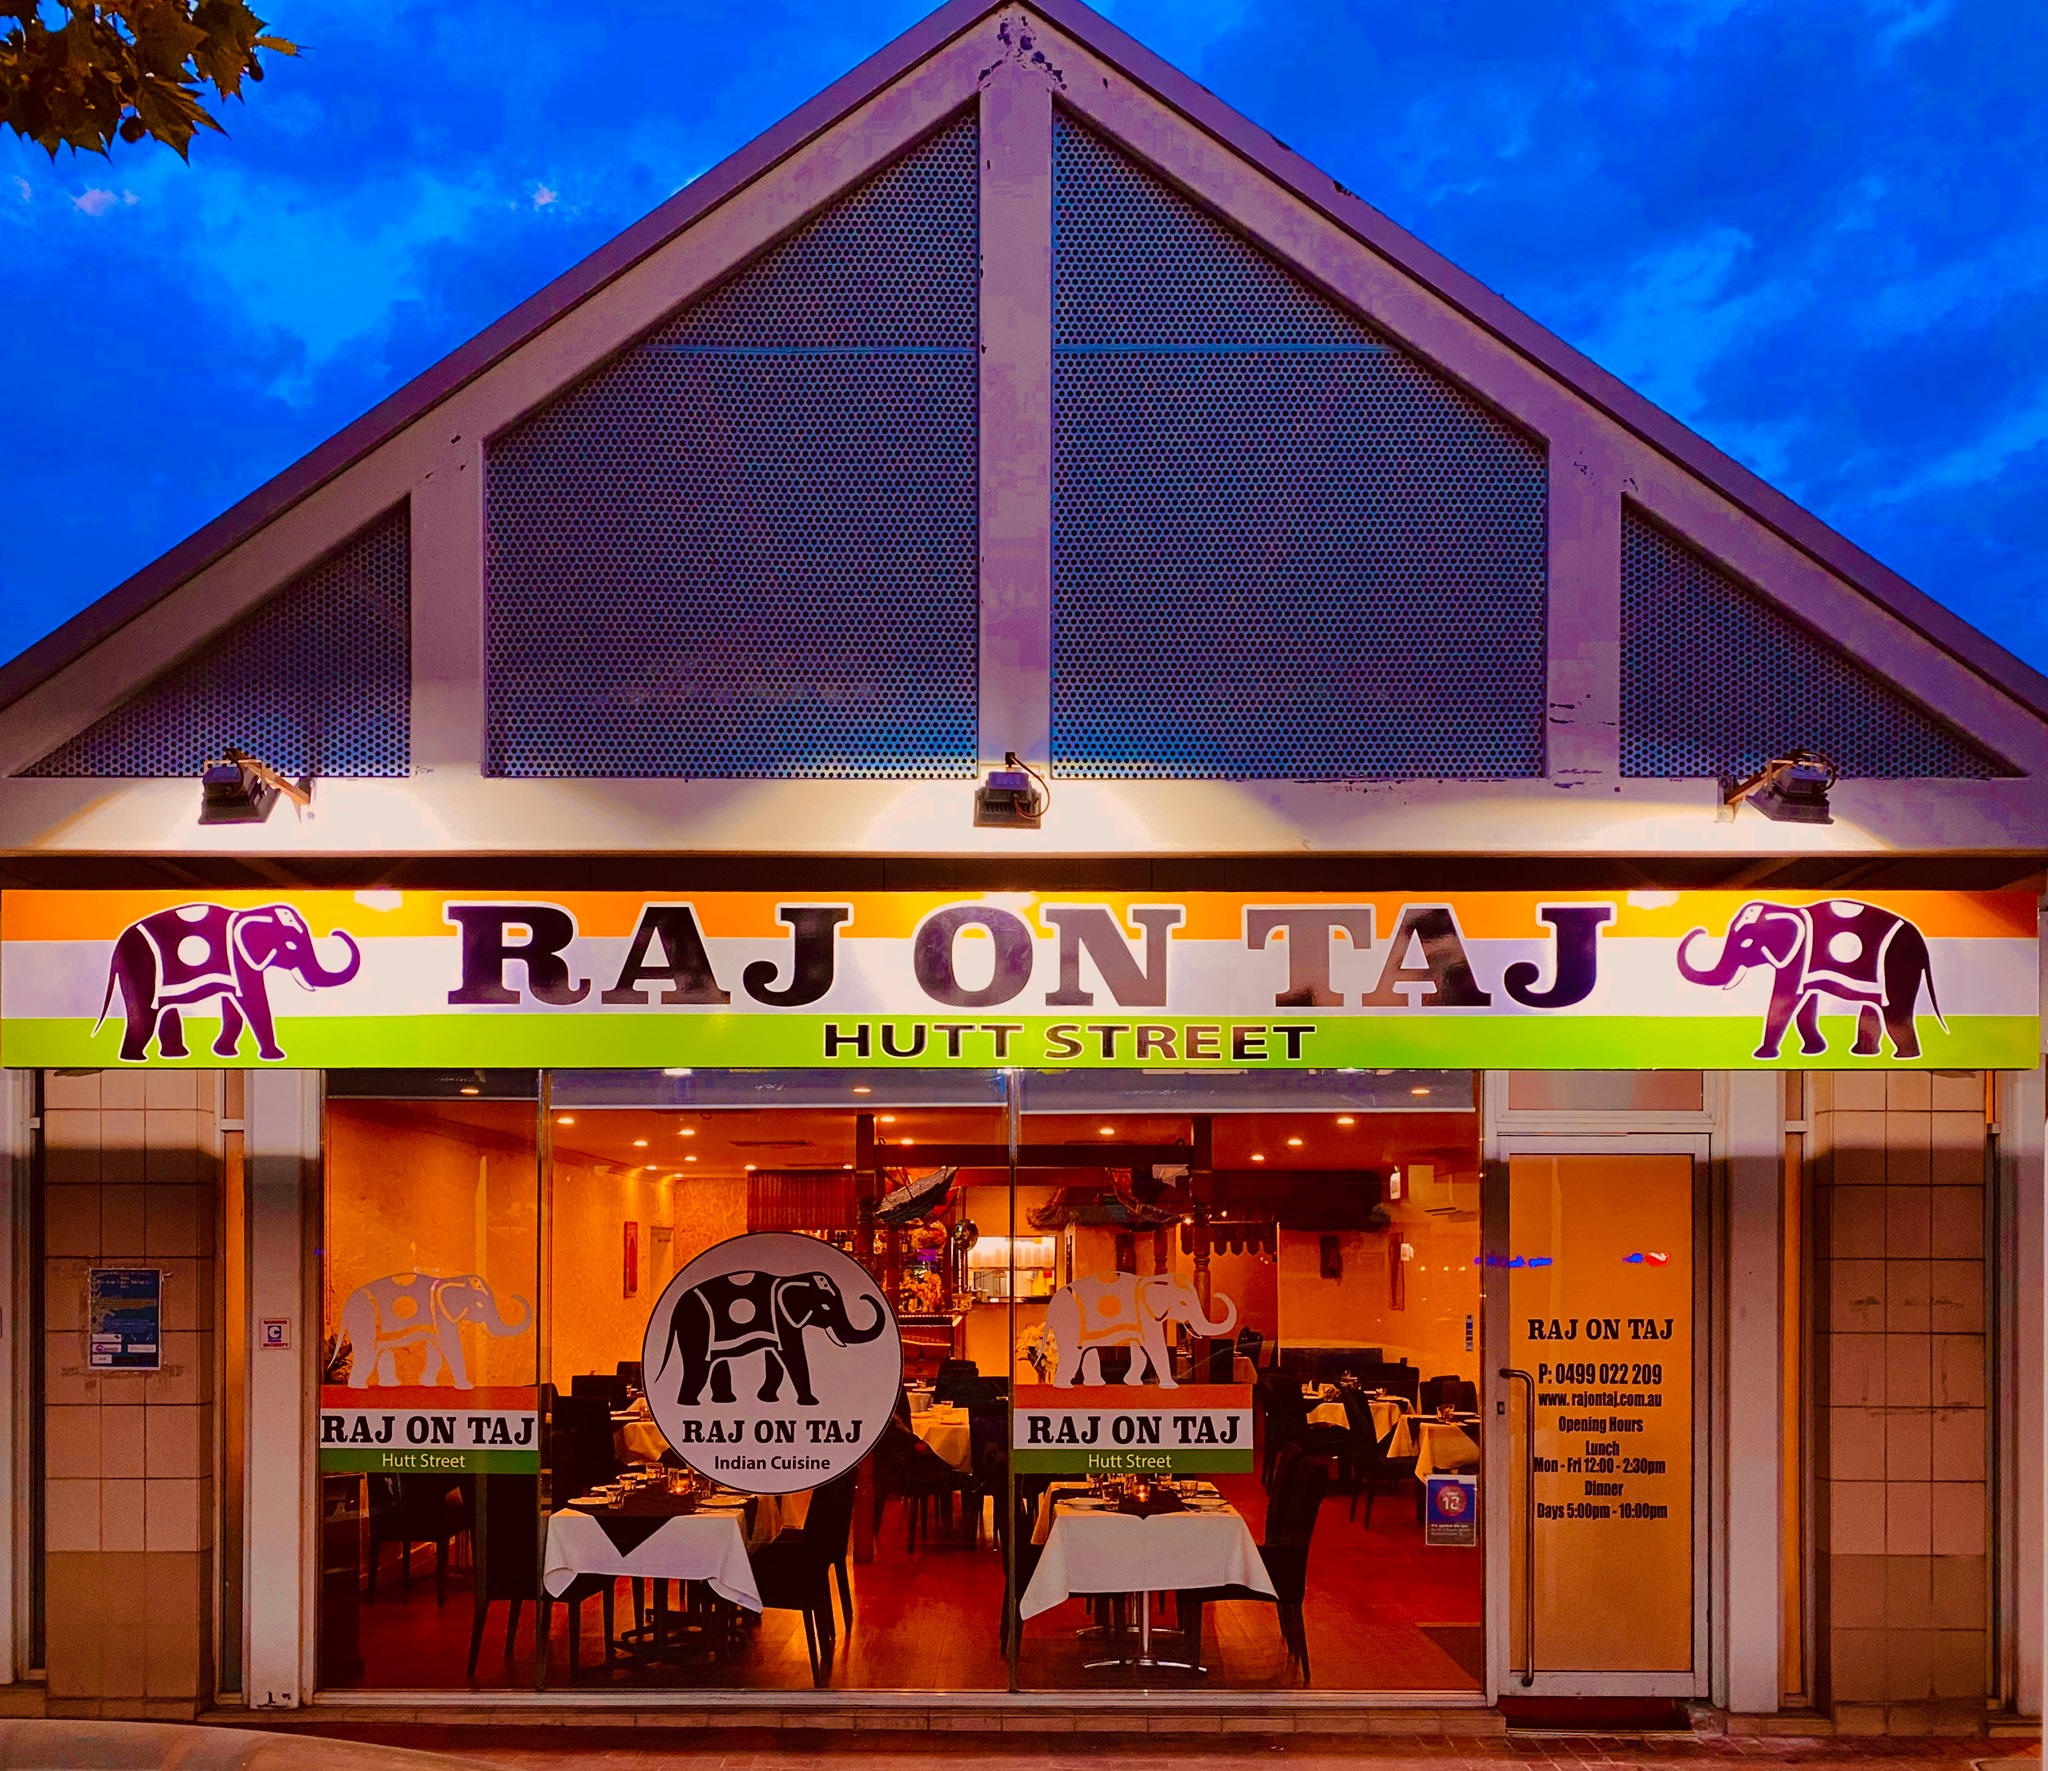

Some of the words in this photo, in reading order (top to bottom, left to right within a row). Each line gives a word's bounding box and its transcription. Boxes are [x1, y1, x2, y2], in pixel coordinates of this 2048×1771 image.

[446, 904, 854, 1008] RAJ
[913, 905, 1183, 1008] ON
[1246, 906, 1612, 1009] TAJ
[824, 1024, 1025, 1058] HUTT
[1045, 1025, 1316, 1060] STREET
[1528, 1318, 1579, 1340] RAJ
[1586, 1318, 1621, 1340] ON
[1628, 1318, 1674, 1340] TAJ
[1538, 1363, 1552, 1384] P:
[1555, 1363, 1596, 1385] 0499
[1600, 1363, 1629, 1385] 022
[1632, 1363, 1662, 1385] 209
[321, 1415, 396, 1443] RAJ
[406, 1415, 457, 1444] ON
[467, 1416, 535, 1445] TAJ
[682, 1419, 745, 1443] RAJ
[754, 1419, 797, 1443] ON
[806, 1419, 863, 1443] TAJ
[1027, 1415, 1101, 1444] RAJ
[1112, 1415, 1162, 1444] ON
[1172, 1415, 1240, 1444] TAJ
[1558, 1415, 1606, 1434] Opening
[1609, 1416, 1644, 1432] Hours
[1585, 1440, 1620, 1456] Lunch
[382, 1453, 417, 1468] Hutt
[420, 1453, 466, 1468] Street
[714, 1455, 767, 1470] Indian
[770, 1455, 831, 1470] Cuisine
[1088, 1453, 1123, 1468] Hutt
[1126, 1453, 1172, 1468] Street
[1534, 1457, 1559, 1473] Mon
[1567, 1457, 1582, 1473] Fri
[1583, 1457, 1614, 1473] 12:00
[1622, 1457, 1666, 1475] 2:30pm
[1584, 1480, 1624, 1496] Dinner
[1537, 1502, 1565, 1520] Days
[1566, 1502, 1610, 1520] 5:00pm
[1618, 1502, 1668, 1520] 10:00pm
